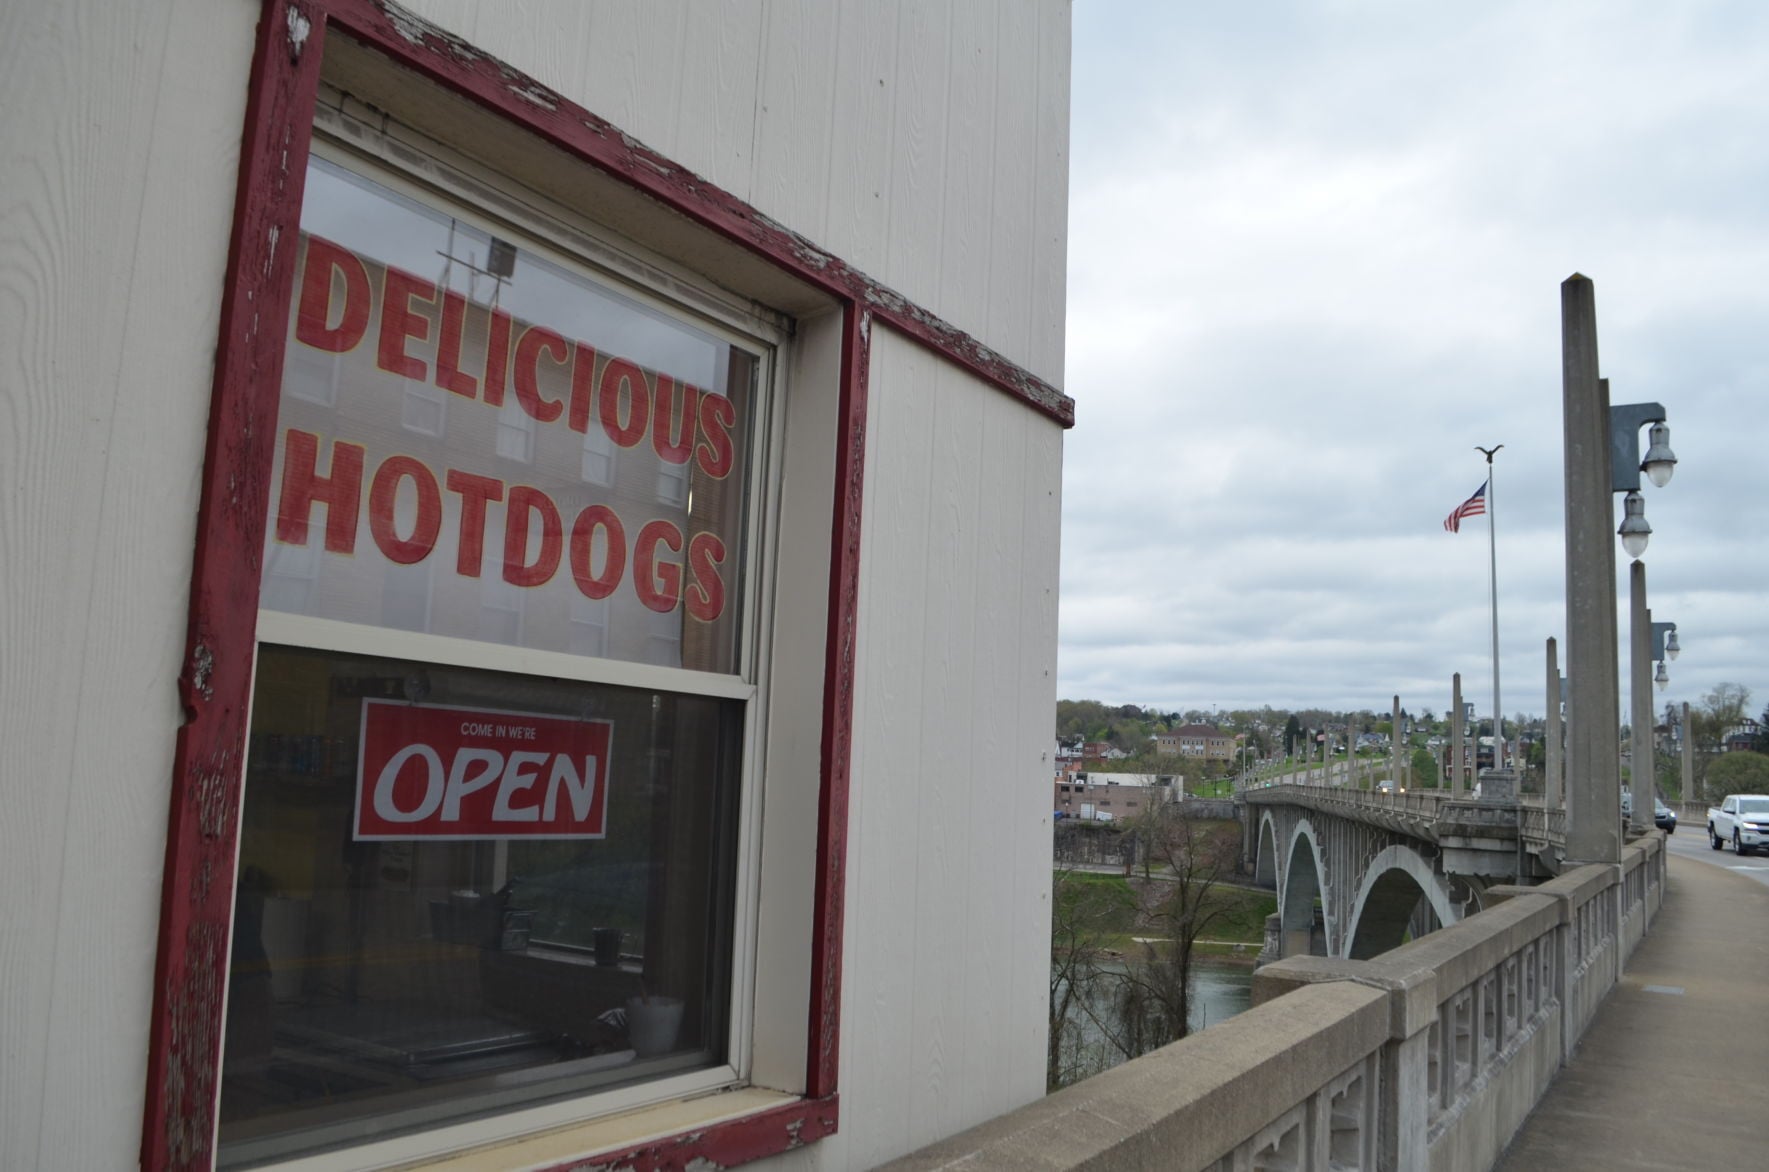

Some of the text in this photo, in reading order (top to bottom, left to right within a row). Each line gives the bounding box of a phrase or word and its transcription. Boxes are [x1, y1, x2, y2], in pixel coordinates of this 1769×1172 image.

[295, 233, 736, 480] DELICIOUS
[461, 722, 537, 740] COME IN WE'RE
[373, 743, 597, 823] OPEN
